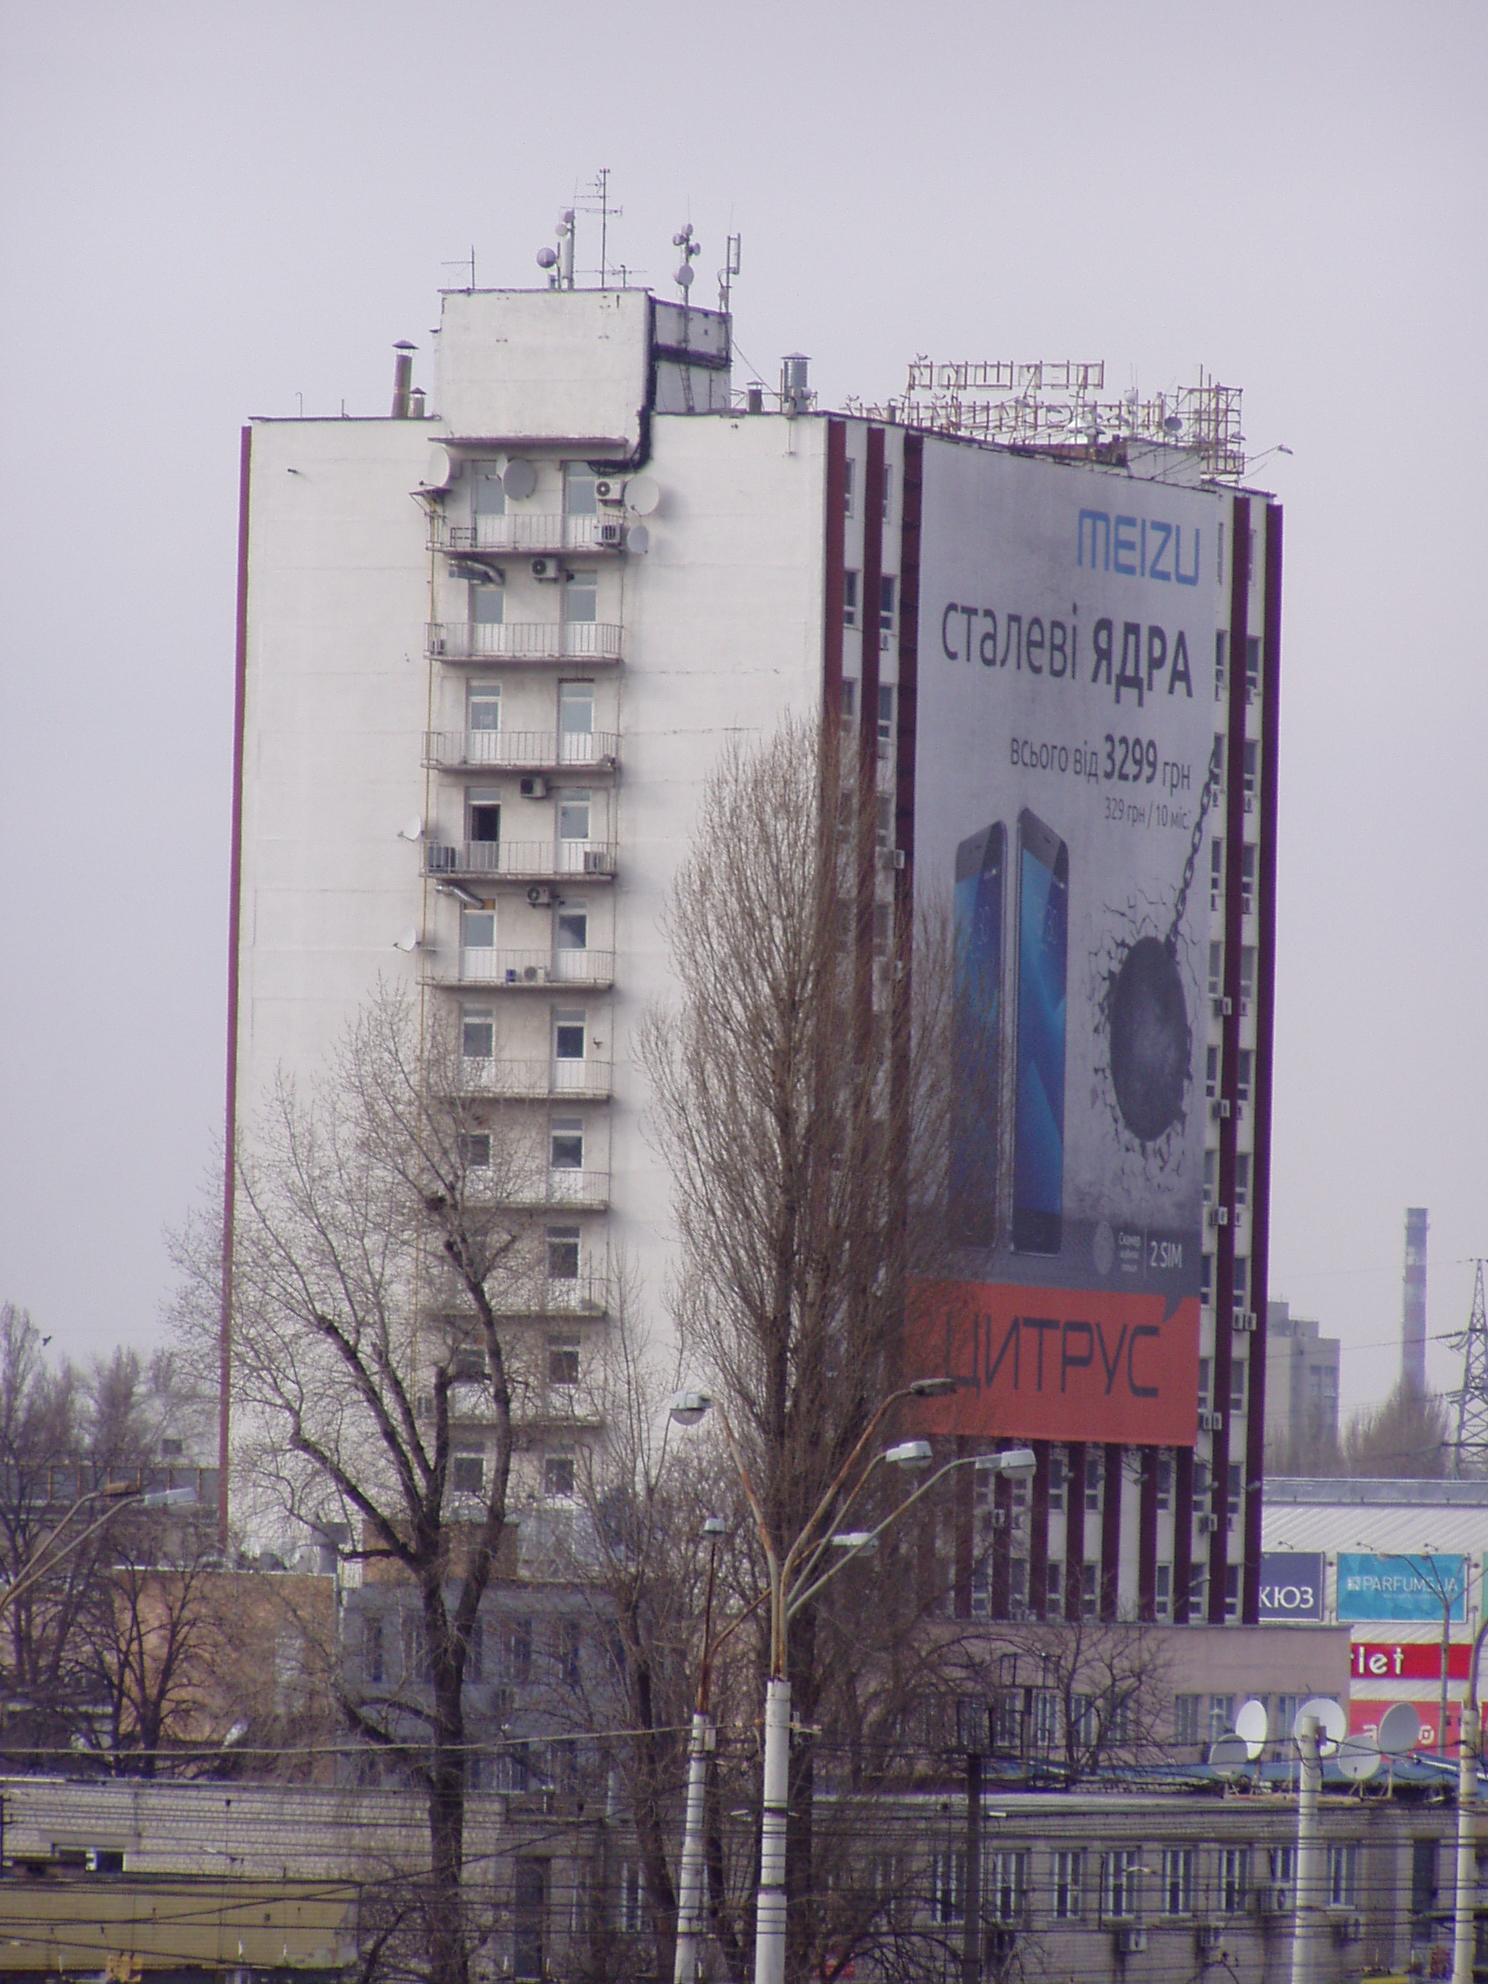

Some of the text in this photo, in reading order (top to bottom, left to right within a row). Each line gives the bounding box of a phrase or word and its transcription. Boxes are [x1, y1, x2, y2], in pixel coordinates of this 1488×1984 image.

[1077, 507, 1200, 586] MEIZU
[1091, 617, 1193, 708] ЯДРА
[1010, 733, 1191, 797] всього від 3299 грн
[1105, 796, 1125, 820] 329
[1127, 804, 1145, 828] грн
[1156, 804, 1169, 827] 10
[945, 1312, 1160, 1399] ЦИТРУС
[1351, 1646, 1404, 1675] let
